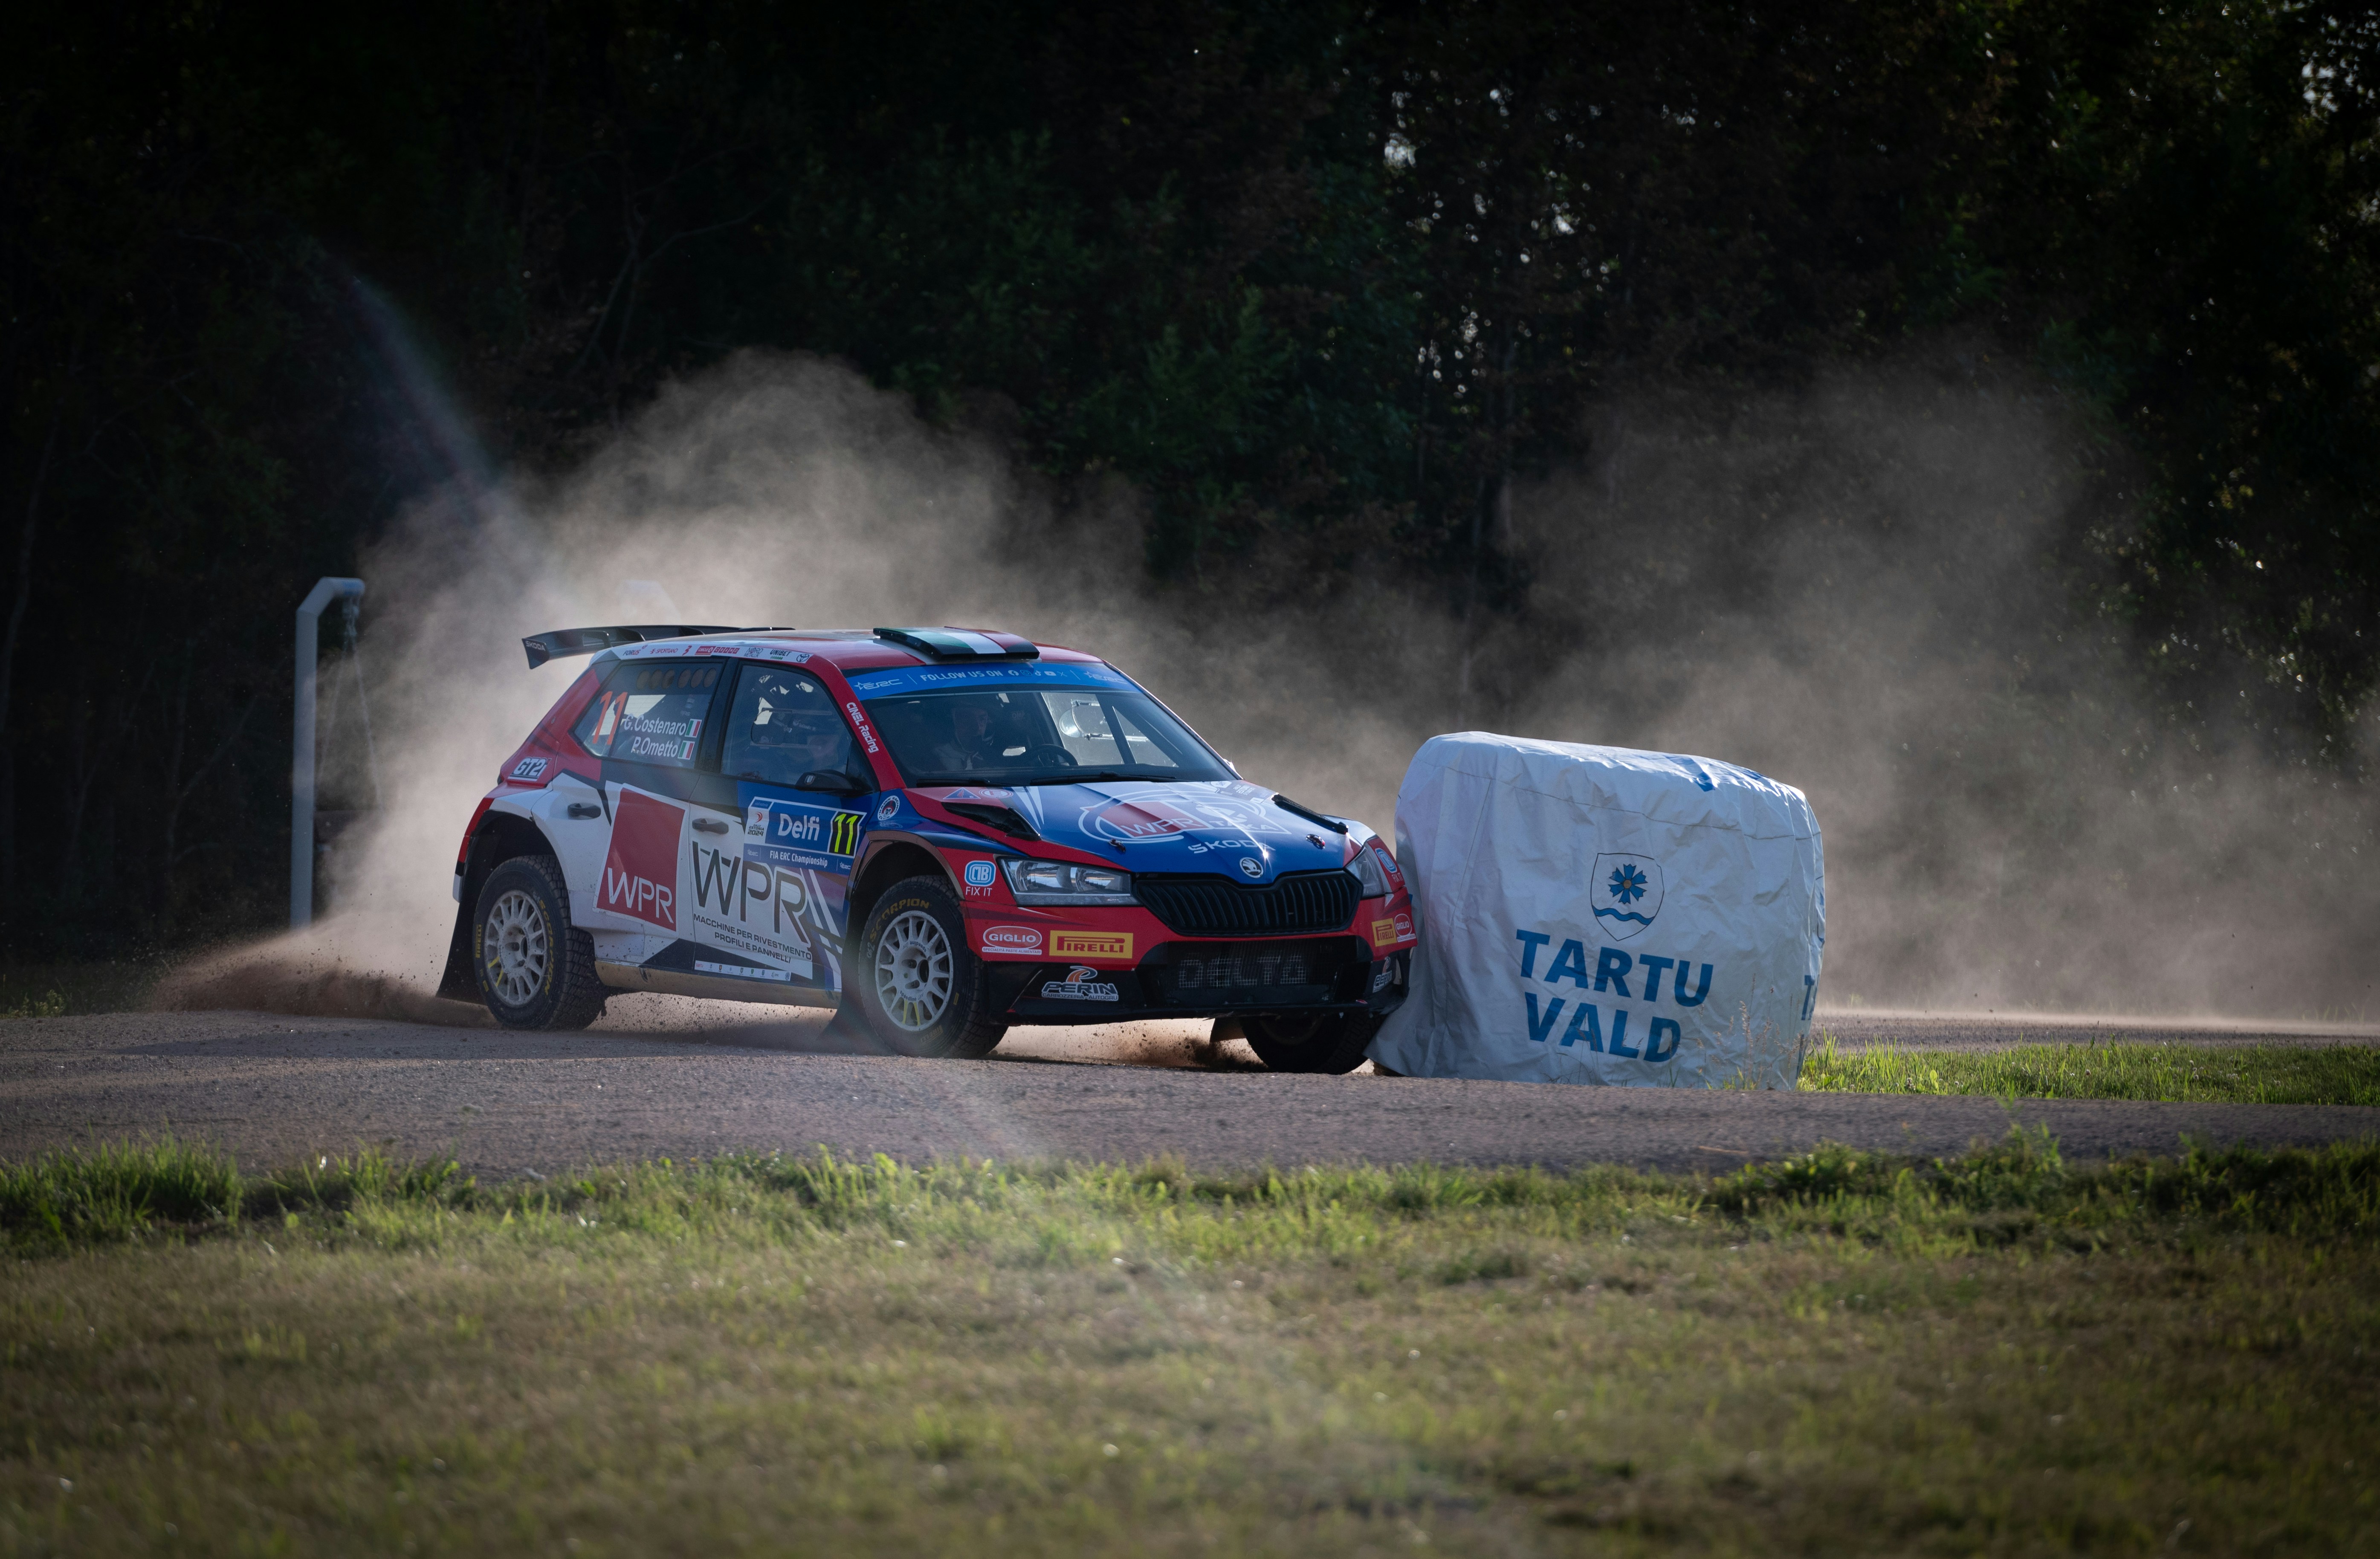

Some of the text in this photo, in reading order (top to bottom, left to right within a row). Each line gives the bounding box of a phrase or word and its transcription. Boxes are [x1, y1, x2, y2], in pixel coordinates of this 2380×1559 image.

[920, 671, 967, 681] FOLLOW
[592, 691, 628, 745] 11
[624, 713, 686, 736] G.Costenaro
[846, 702, 879, 753] CINEL Racing
[631, 736, 678, 758] P.Ometto
[777, 813, 858, 854] Delfi 11
[1119, 817, 1200, 836] WPR
[770, 850, 828, 868] FIA ERC Championship
[607, 867, 675, 925] WPR
[692, 840, 808, 944] WPR
[965, 886, 993, 897] FIX IT
[870, 898, 930, 942] SCORPION
[1396, 922, 1410, 931] GIGLIO
[693, 913, 812, 960] MACCHINE PER RIVESTMENTO
[989, 933, 1037, 943] GIGLIO
[1375, 924, 1394, 941] PIRELLI
[715, 932, 744, 948] PROFILI
[752, 944, 791, 964] PANNELLI
[1056, 935, 1126, 953] PIRELLI
[1515, 928, 1714, 1008] TARTU
[900, 990, 917, 1001] speedline
[1043, 982, 1118, 995] PERIN
[1524, 992, 1682, 1063] VALD
